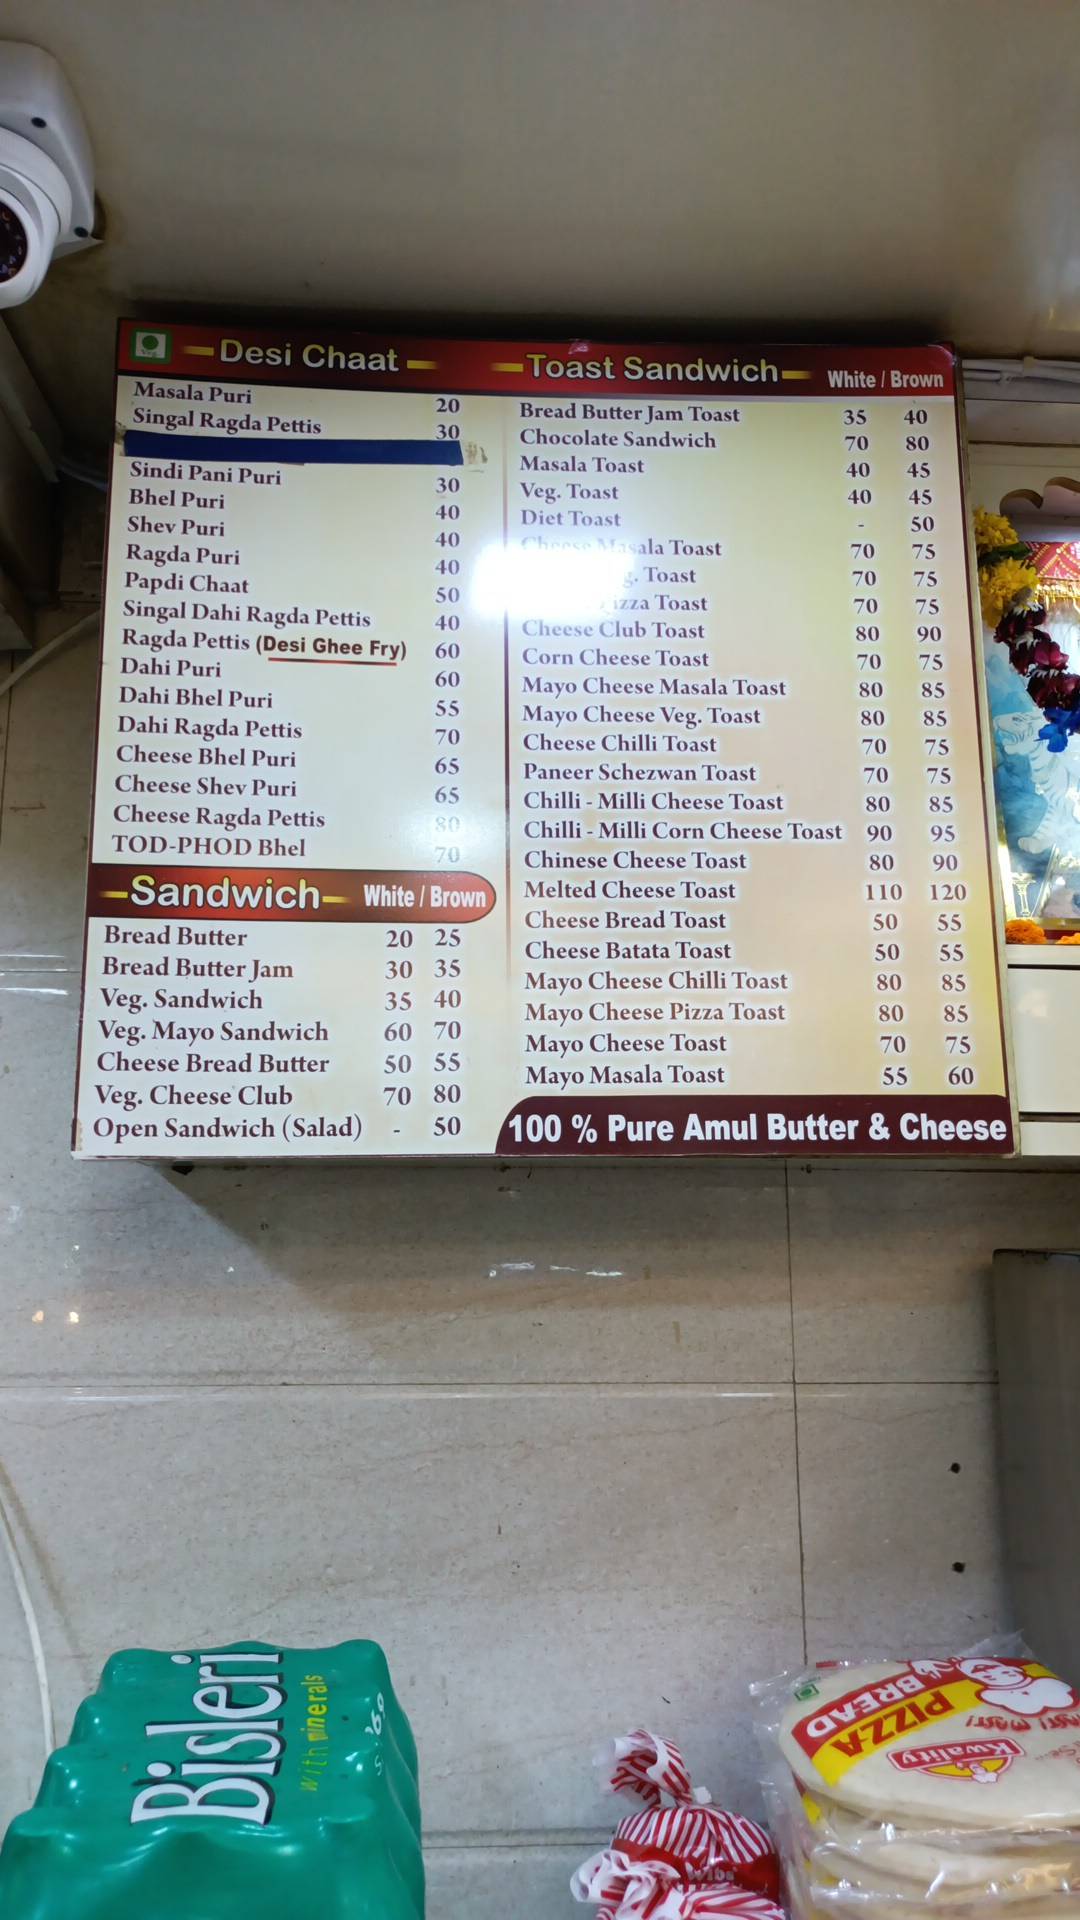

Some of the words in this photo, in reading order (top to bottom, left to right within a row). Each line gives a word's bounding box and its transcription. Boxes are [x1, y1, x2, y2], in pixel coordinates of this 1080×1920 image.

[220, 339, 291, 366] Desi
[302, 344, 399, 372] Chaat
[526, 354, 615, 379] Toast
[624, 356, 778, 382] Sandwich
[828, 370, 876, 388] White
[890, 370, 944, 388] Brown
[133, 381, 204, 401] Masala
[208, 387, 252, 404] Puri
[436, 398, 460, 414] 20
[133, 407, 194, 430] Singal
[199, 412, 262, 434] Ragda
[267, 416, 322, 433] Pettis
[436, 424, 460, 439] 30
[520, 402, 577, 419] Bread
[582, 404, 642, 421] Butter
[646, 406, 684, 425] Jam
[687, 406, 740, 422] Toast
[844, 409, 867, 426] 35
[904, 409, 928, 425] 40
[520, 428, 619, 446] Chocolate
[623, 431, 716, 449] Sandwich
[845, 436, 869, 451] 70
[906, 436, 930, 451] 80
[130, 461, 183, 480] Sindi
[188, 465, 233, 483] Pani
[238, 468, 281, 486] Puri
[436, 477, 460, 493] 30
[127, 515, 176, 534] Shev
[181, 519, 225, 537] Puri
[435, 532, 460, 548] 40
[125, 571, 184, 595] Papdi
[189, 574, 249, 594] Chaat
[435, 587, 460, 604] 50
[123, 600, 186, 625] Singal
[192, 603, 241, 622] Dahi
[247, 606, 310, 630] Ragda
[315, 609, 371, 627] Pettis
[435, 615, 460, 631] 40
[654, 594, 708, 611] Toast
[854, 598, 878, 614] 70
[915, 599, 939, 615] 75
[122, 628, 187, 653] Ragda
[193, 632, 250, 650] Pettis
[256, 635, 306, 656] (Desi
[312, 637, 363, 656] Ghee
[370, 640, 407, 661] Fry)
[435, 642, 460, 659] 60
[119, 686, 169, 705] Dahi
[176, 688, 223, 707] Bhel
[228, 691, 273, 709] Puri
[435, 700, 460, 717] 55
[522, 676, 577, 700] Mayo
[583, 676, 654, 695] Cheese
[659, 678, 728, 696] Masala
[732, 679, 786, 696] Toast
[859, 682, 883, 698] 80
[922, 682, 945, 699] 85
[118, 715, 168, 734] Dahi
[174, 718, 239, 742] Ragda
[245, 720, 303, 739] Pettis
[435, 729, 460, 745] 70
[523, 733, 596, 751] Cheese
[601, 734, 657, 752] Chilli
[662, 735, 717, 752] Toast
[862, 738, 887, 755] 70
[925, 739, 949, 756] 75
[116, 744, 193, 764] Cheese
[198, 747, 245, 766] Bhel
[252, 750, 296, 768] Puri
[435, 757, 460, 775] 65
[524, 763, 594, 780] Paneer
[598, 762, 697, 781] Schezwan
[701, 764, 756, 782] Toast
[864, 767, 889, 784] 70
[927, 767, 951, 785] 75
[524, 820, 582, 839] Chilli
[599, 821, 647, 839] Milli
[652, 822, 705, 840] Corn
[710, 821, 783, 840] Cheese
[787, 823, 842, 840] Toast
[867, 825, 893, 842] 90
[930, 825, 956, 843] 95
[112, 834, 252, 856] TOD-PHOD
[258, 838, 305, 857] Bhel
[435, 846, 461, 864] 70
[131, 875, 320, 909] Sandwich
[363, 885, 415, 907] White
[430, 886, 486, 907] Brown
[524, 880, 597, 899] Melted
[602, 880, 676, 899] Cheese
[680, 881, 736, 899] Toast
[867, 883, 903, 901] 110
[930, 884, 967, 901] 120
[104, 925, 171, 945] Bread
[176, 926, 248, 947] Butter
[386, 930, 413, 949] 20
[435, 928, 461, 948] 25
[525, 940, 600, 960] Cheese
[606, 942, 671, 960] Batata
[675, 941, 732, 959] Toast
[875, 944, 900, 962] 50
[940, 944, 964, 962] 55
[102, 956, 169, 977] Bread
[175, 958, 248, 978] Butter
[248, 961, 294, 983] Jam
[385, 960, 413, 980] 30
[434, 959, 461, 978] 35
[524, 1003, 584, 1028] Mayo
[589, 1001, 664, 1021] Cheese
[670, 1002, 724, 1021] Pizza
[728, 1002, 785, 1021] Toast
[879, 1004, 904, 1022] 80
[944, 1005, 969, 1023] 85
[98, 1020, 146, 1047] Veg.
[152, 1019, 215, 1047] Mayo
[220, 1021, 329, 1041] Sandwich
[384, 1022, 412, 1042] 60
[434, 1021, 461, 1041] 70
[525, 1066, 585, 1091] Mayo
[589, 1064, 663, 1084] Masala
[667, 1065, 725, 1084] Toast
[883, 1067, 908, 1086] 55
[948, 1066, 974, 1085] 60
[94, 1085, 143, 1112] Veg.
[150, 1084, 232, 1105] Cheese
[238, 1085, 293, 1106] Club
[383, 1086, 412, 1106] 70
[433, 1084, 461, 1104] 80
[93, 1117, 158, 1144] Open
[164, 1117, 275, 1138] Sandwich
[282, 1113, 362, 1143] (Salad)
[433, 1116, 461, 1137] 50
[509, 1114, 561, 1142] 100
[571, 1114, 597, 1143] %
[608, 1115, 674, 1141] Pure
[683, 1114, 757, 1141] Amul
[767, 1113, 859, 1140] Butter
[868, 1112, 890, 1140] &
[900, 1112, 1007, 1141] Cheese
[806, 1675, 926, 1738] BREAD
[830, 1690, 955, 1757] PIZZA
[130, 1653, 283, 1826] Bisleri
[902, 1743, 1014, 1764] Kwality
